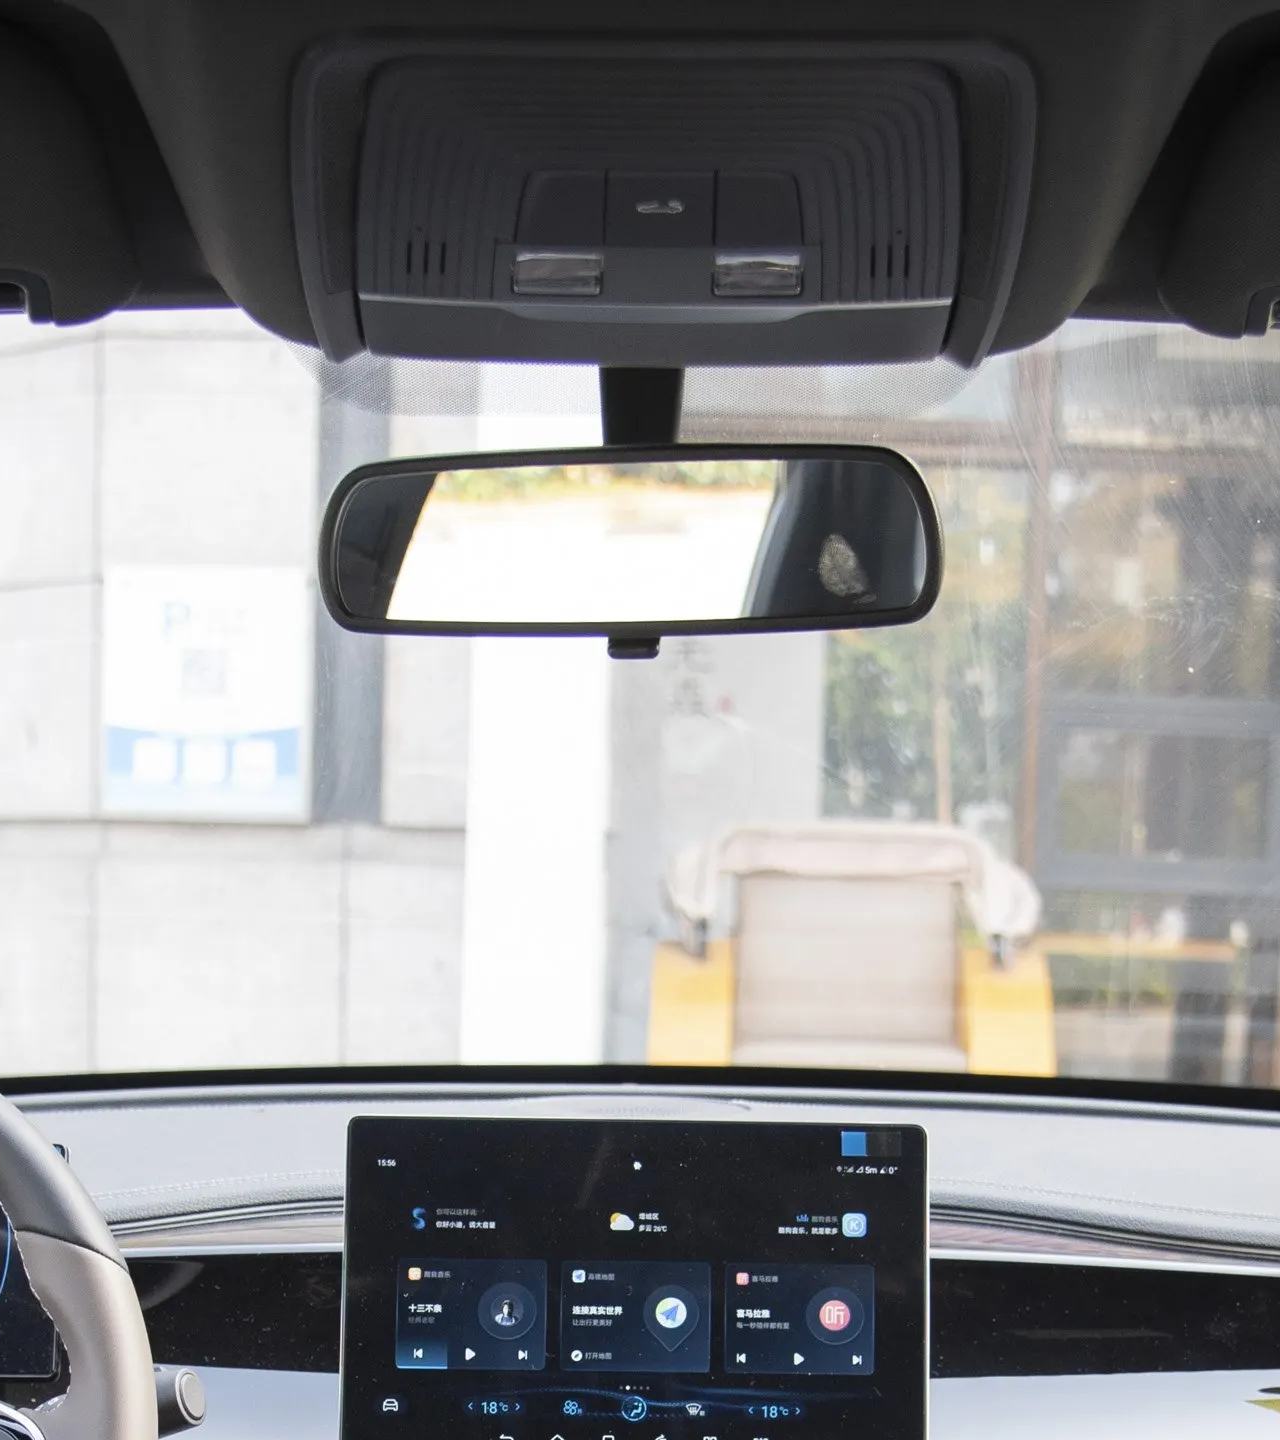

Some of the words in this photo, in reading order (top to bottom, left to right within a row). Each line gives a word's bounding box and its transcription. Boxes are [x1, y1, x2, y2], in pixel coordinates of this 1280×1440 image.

[377, 1159, 397, 1167] 15:56
[572, 1305, 623, 1315] 连接真实世界
[736, 1309, 771, 1318] 喜马拉雅
